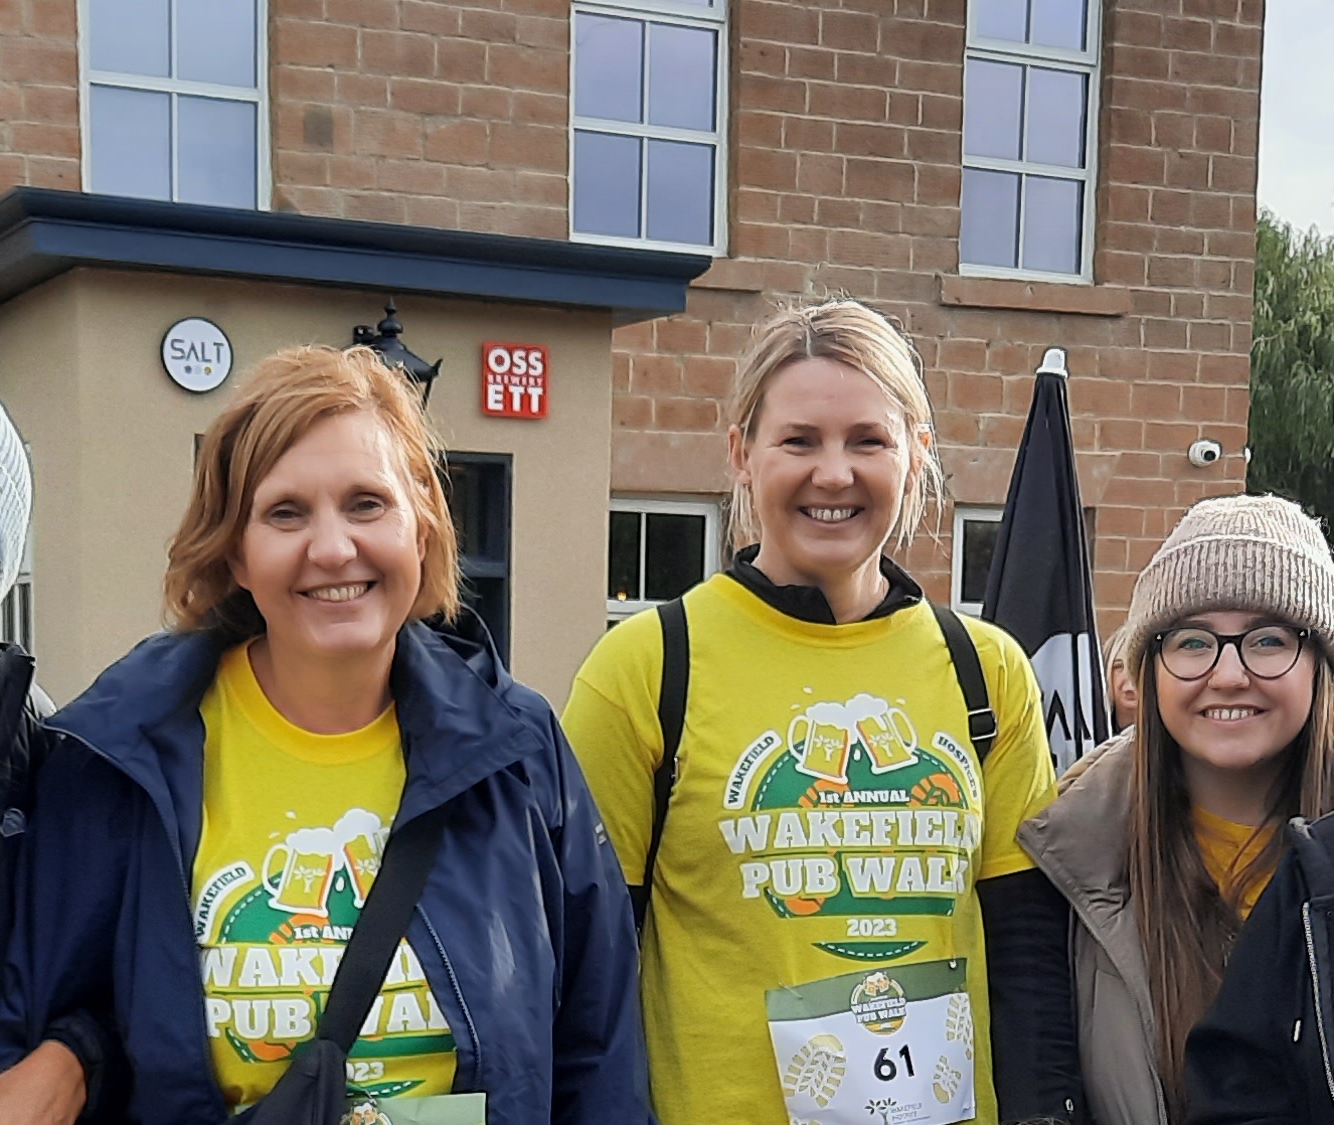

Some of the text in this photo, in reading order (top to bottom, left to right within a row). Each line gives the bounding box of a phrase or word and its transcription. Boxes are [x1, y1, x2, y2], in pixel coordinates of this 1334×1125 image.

[170, 338, 224, 364] SALT
[488, 347, 543, 376] OSS
[487, 384, 543, 413] ETT
[727, 735, 775, 804] WAKEFIELD
[819, 789, 910, 804] 1st ANNUAL
[718, 809, 979, 855] WAKEFIELD
[739, 856, 970, 899] PUB WALK
[193, 865, 248, 938] WAKEFIELD
[294, 925, 320, 940] 1st
[846, 918, 898, 937] 2023
[206, 998, 313, 1038] PUB
[346, 1062, 385, 1082] 023
[873, 1043, 916, 1082] 61
